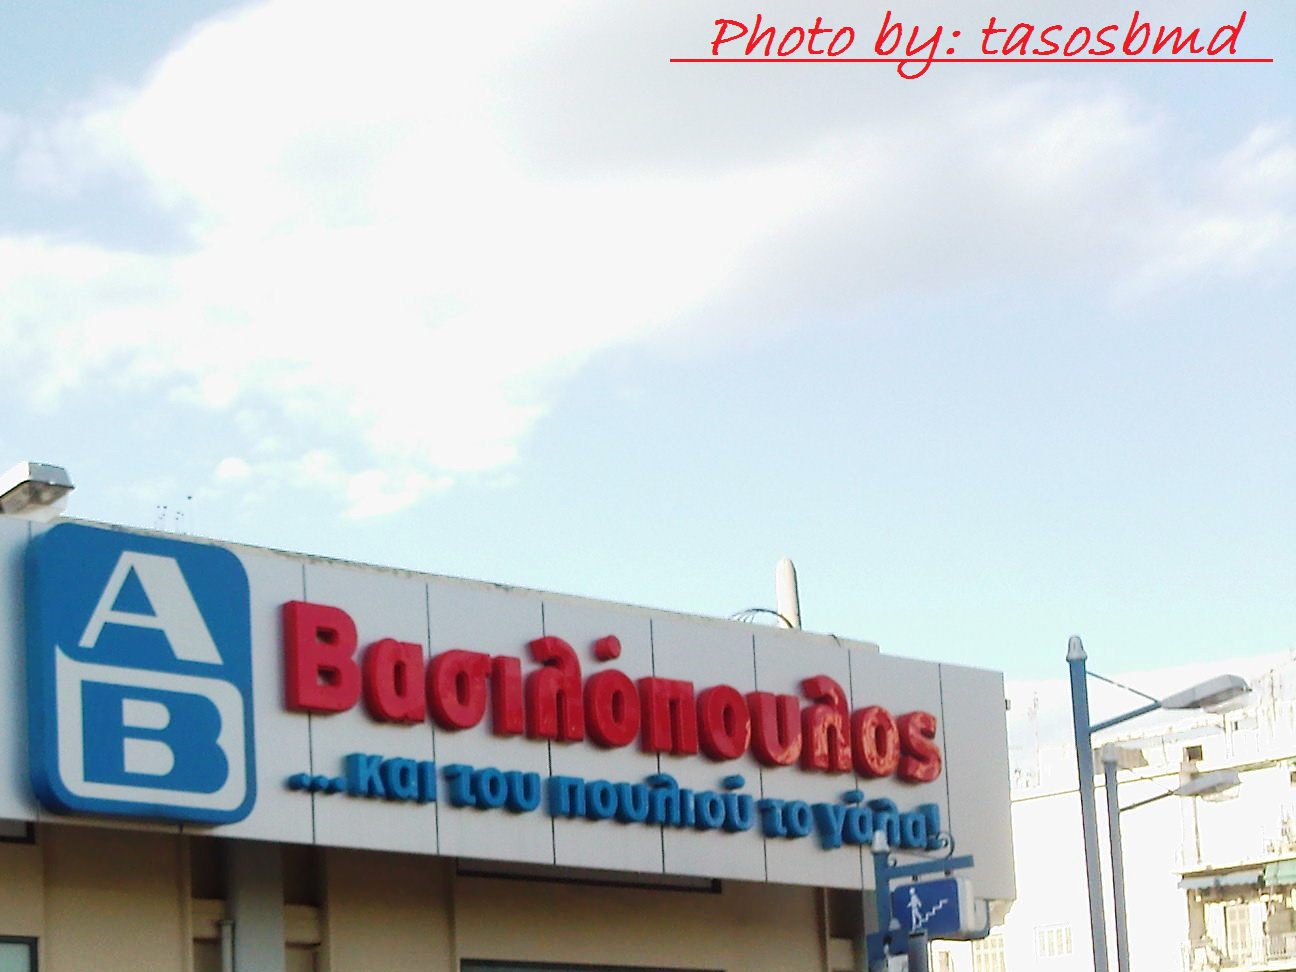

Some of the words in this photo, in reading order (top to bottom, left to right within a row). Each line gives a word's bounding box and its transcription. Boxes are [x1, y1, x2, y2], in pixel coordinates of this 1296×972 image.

[282, 600, 943, 784] Βασιλόπουλος
[447, 763, 542, 813] του
[545, 772, 754, 833] πουλιού
[757, 797, 811, 839] το
